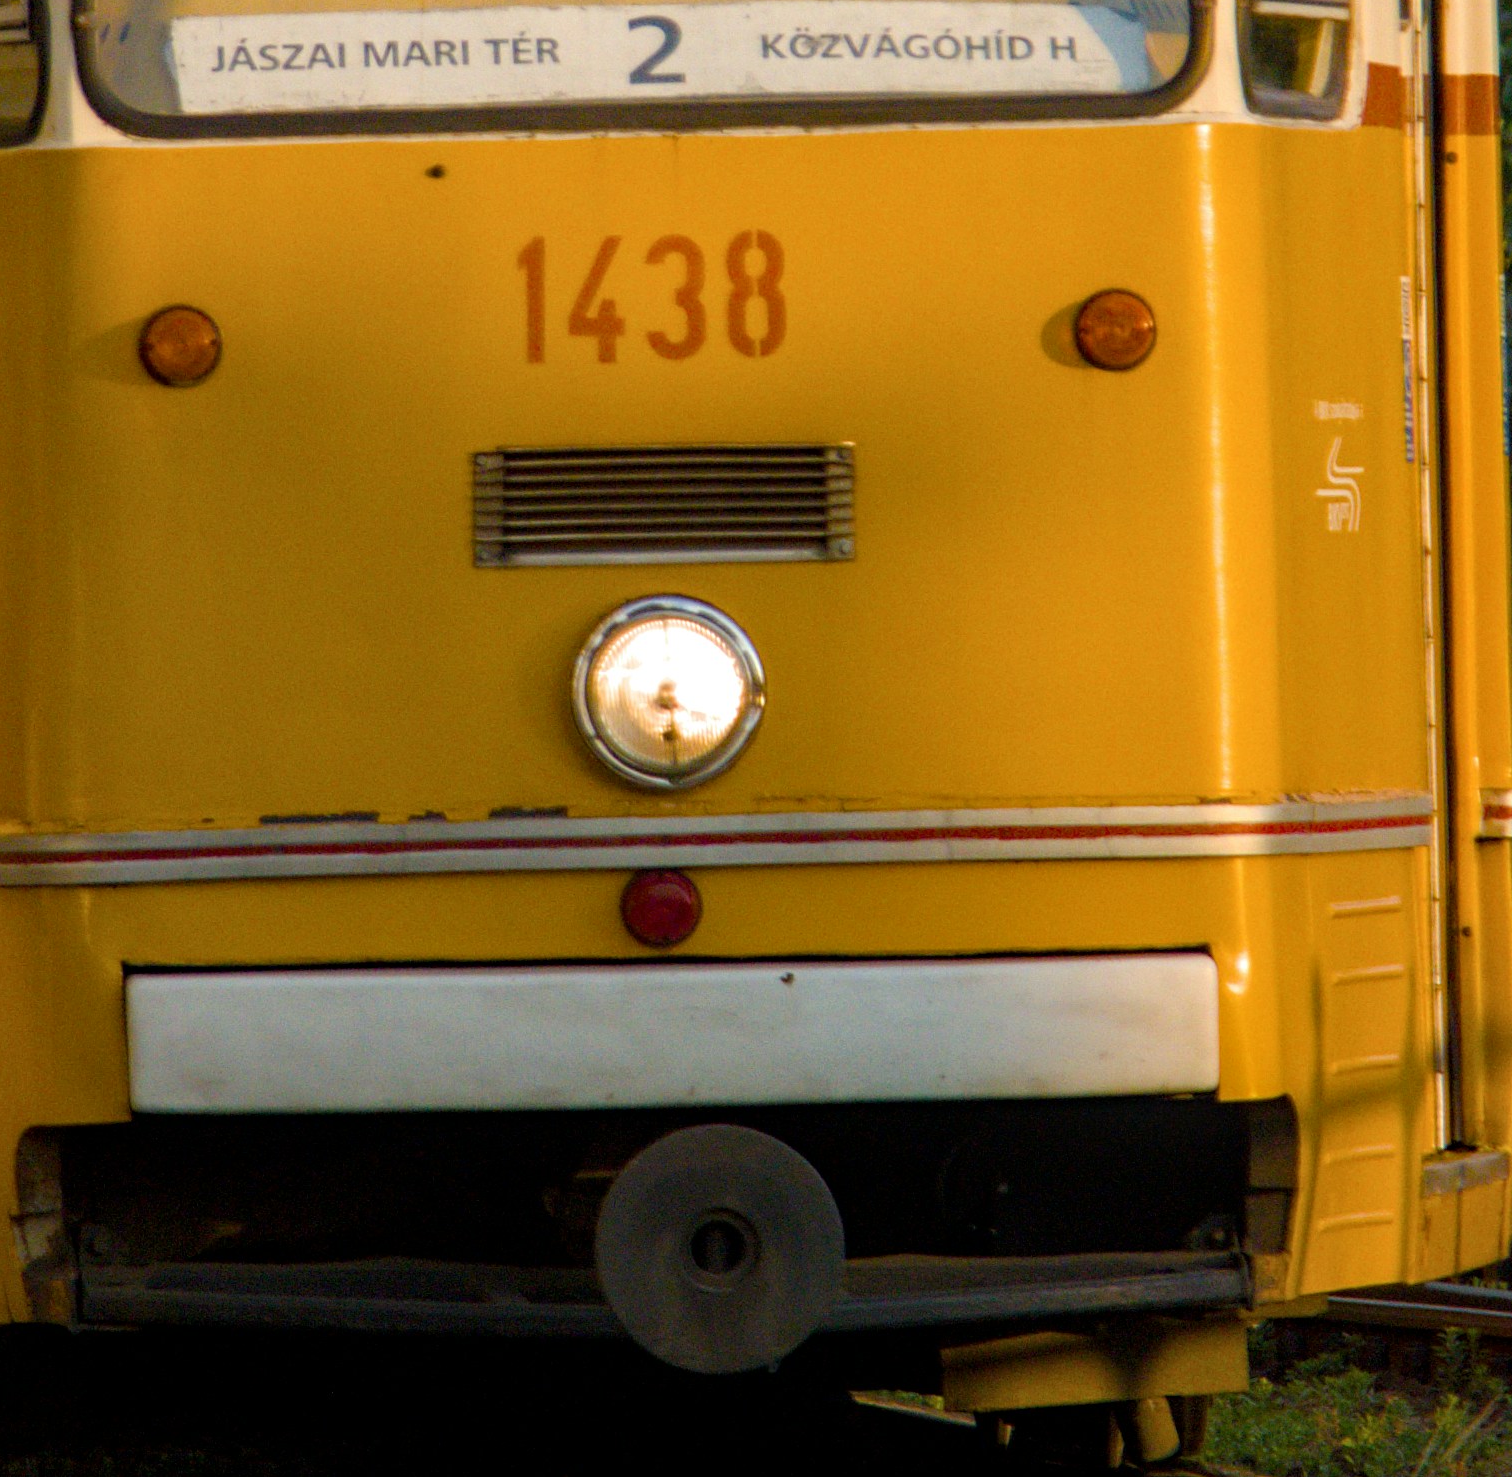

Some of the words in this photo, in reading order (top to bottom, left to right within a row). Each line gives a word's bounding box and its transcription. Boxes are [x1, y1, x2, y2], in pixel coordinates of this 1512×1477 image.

[212, 38, 347, 72] JÁSZAI
[362, 39, 470, 68] MARI
[484, 31, 560, 65] TÉR
[627, 14, 686, 84] 2
[760, 27, 1034, 60] KÖZVÁGÓHÍD
[1050, 36, 1077, 60] H
[517, 229, 787, 363] 1438
